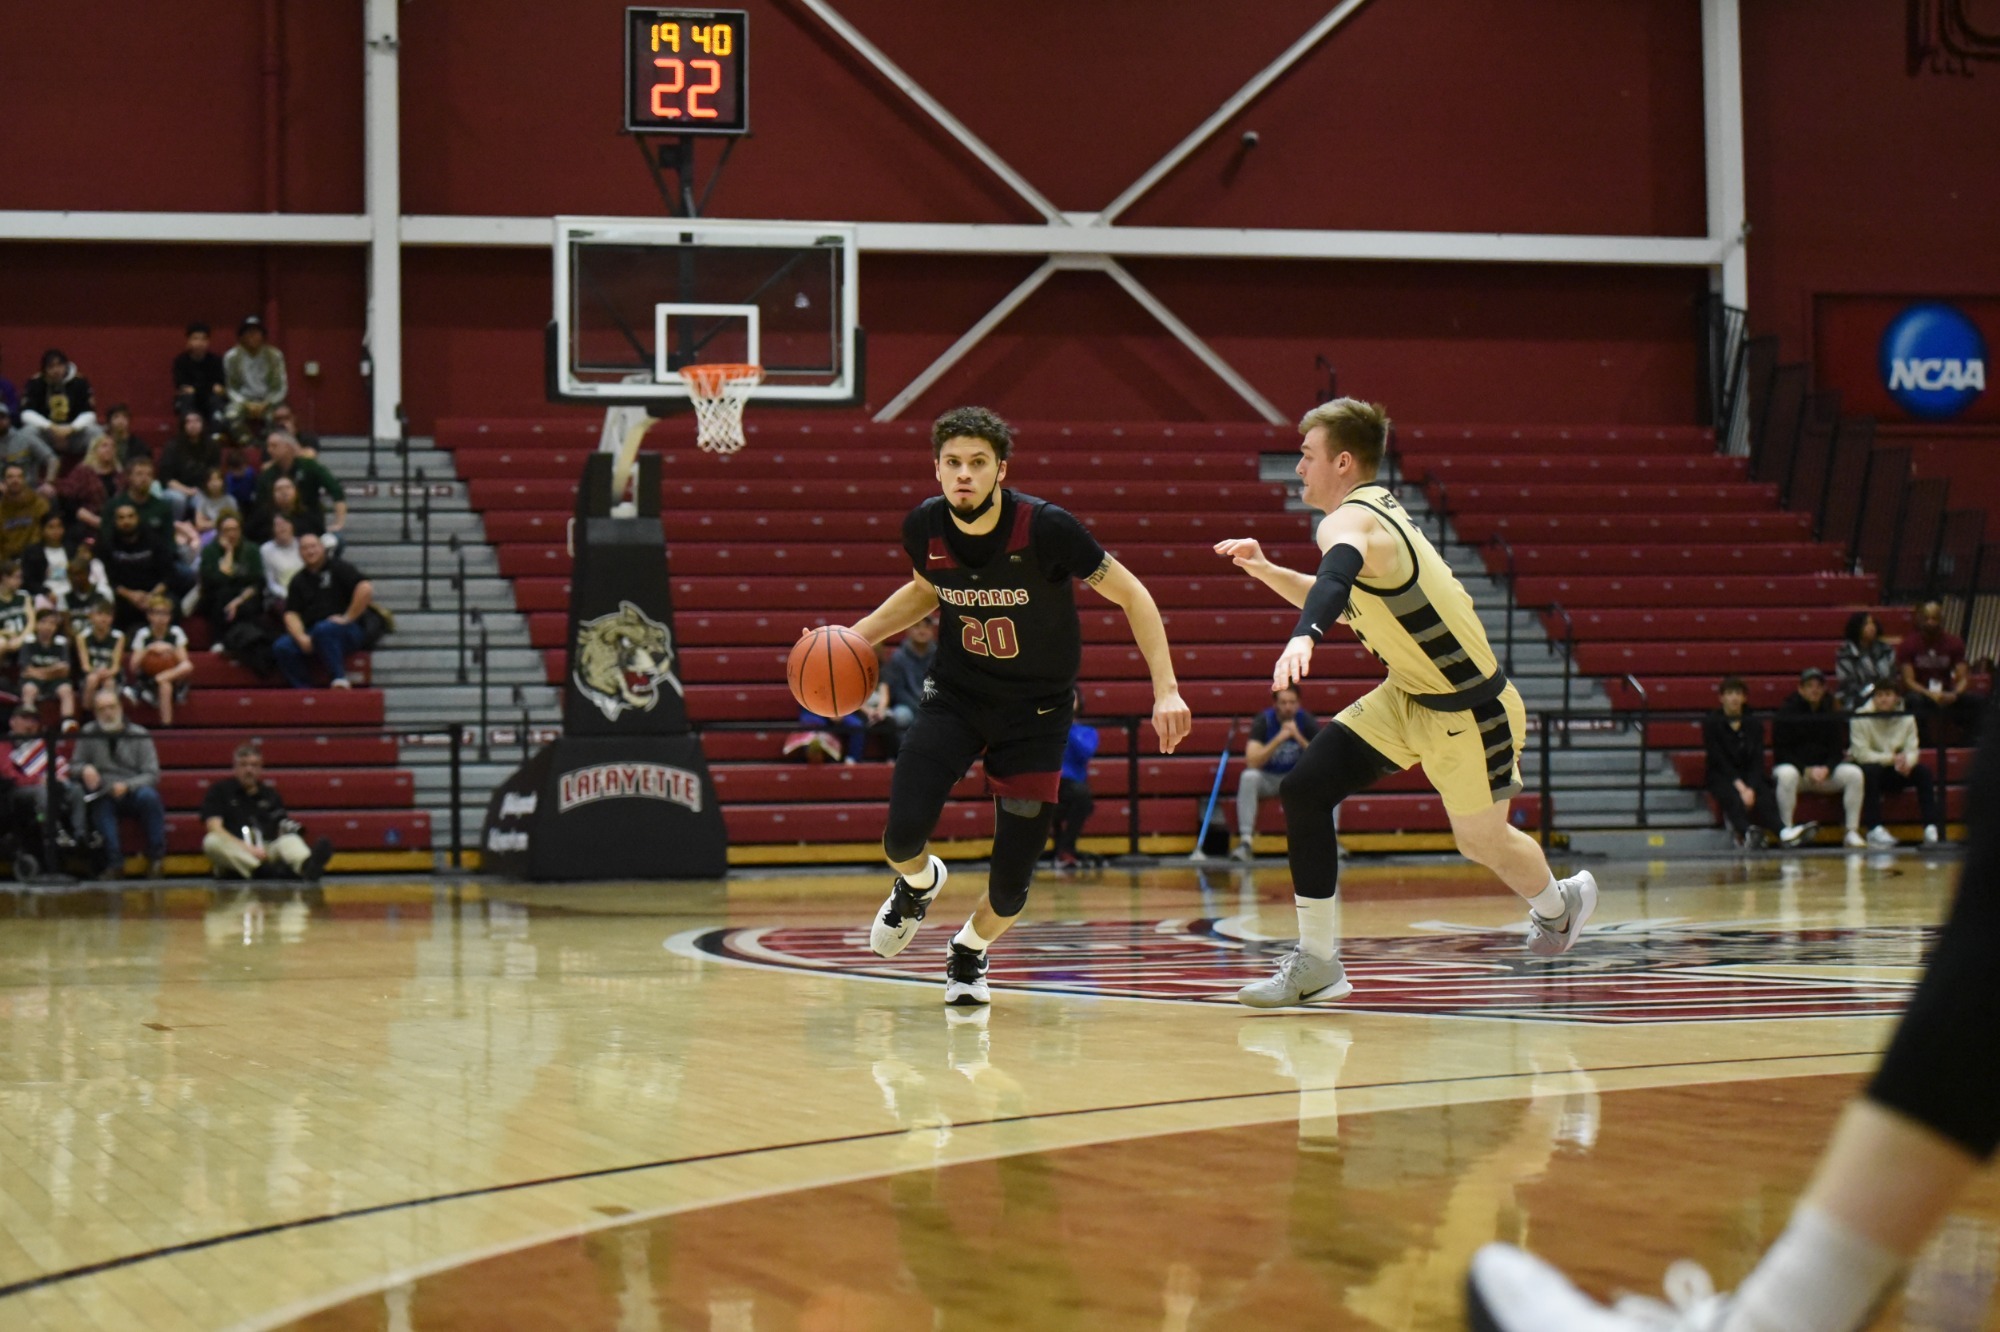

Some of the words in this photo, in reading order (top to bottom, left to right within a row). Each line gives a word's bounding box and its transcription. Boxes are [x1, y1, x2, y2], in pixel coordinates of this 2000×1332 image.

[651, 22, 680, 53] 19
[691, 24, 732, 56] 40
[650, 58, 721, 118] 22
[1888, 358, 1985, 391] NCAA
[934, 585, 1029, 606] LEOPARDS
[959, 615, 1019, 659] 20
[559, 762, 702, 813] LAFAYETTE
